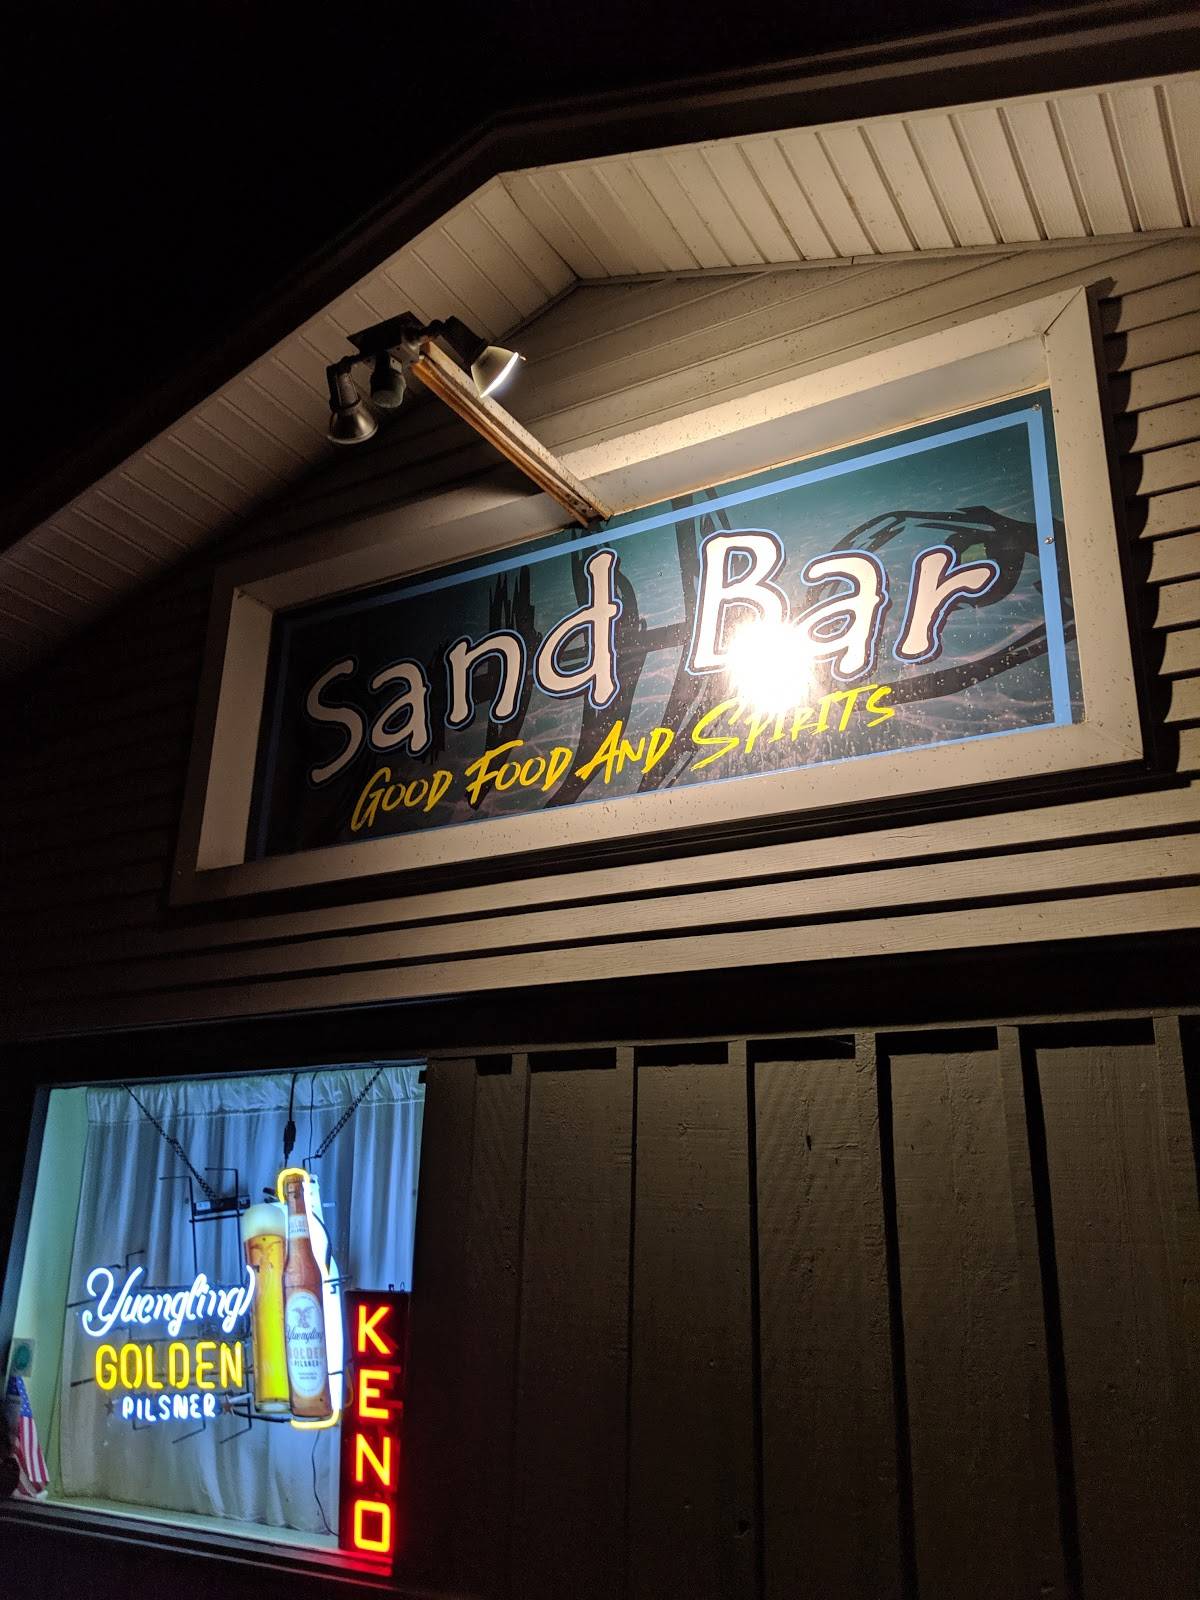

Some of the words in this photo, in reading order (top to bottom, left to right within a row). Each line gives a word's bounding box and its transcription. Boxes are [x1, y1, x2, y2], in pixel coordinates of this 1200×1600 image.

[303, 549, 623, 786] Sand
[686, 529, 1000, 681] Bar
[82, 1265, 256, 1337] Yuengling
[95, 1341, 243, 1390] GOLDEN
[122, 1393, 216, 1422] PILSNER
[354, 1305, 391, 1552] KENO
